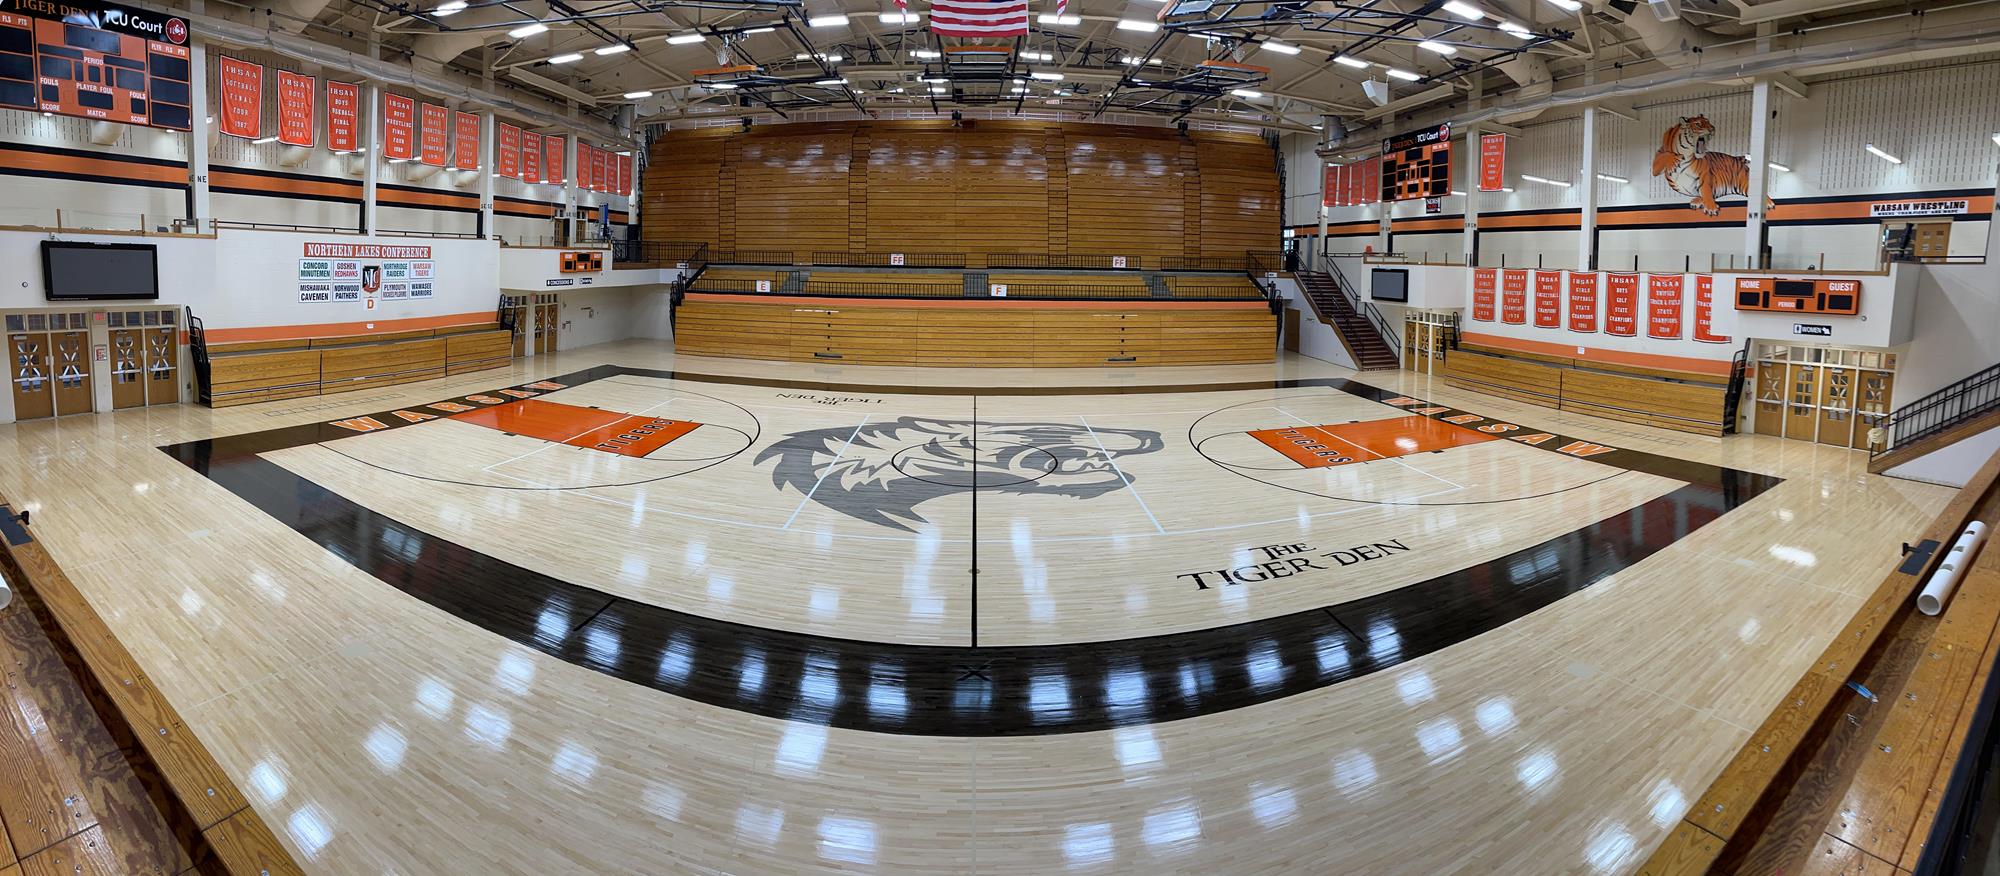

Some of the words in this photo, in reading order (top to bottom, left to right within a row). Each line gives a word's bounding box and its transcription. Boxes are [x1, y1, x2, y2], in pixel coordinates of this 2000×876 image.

[15, 0, 56, 15] TIGER
[104, 10, 128, 26] TCU
[131, 16, 163, 34] Court
[84, 57, 104, 65] PERIOD
[226, 65, 257, 79] IHSAA
[40, 77, 59, 87] FOULS
[282, 78, 310, 90] IHSAA
[76, 82, 98, 93] PLAYER
[100, 86, 114, 95] FOUL
[330, 88, 354, 97] IHSAA
[129, 91, 146, 100] FOULS
[230, 93, 252, 104] FINAL
[42, 103, 60, 111] SCORE
[335, 98, 349, 106] BOYS
[87, 109, 106, 118] MATCH
[131, 115, 147, 124] SCORE
[1874, 203, 1910, 212] WARSAW
[1913, 201, 1965, 211] WRESTLING
[355, 245, 380, 257] LAKES
[382, 246, 428, 258] CONFERENCE
[303, 262, 328, 270] CONCORD
[1740, 280, 1760, 289] HOME
[1829, 282, 1855, 292] GUEST
[368, 299, 374, 309] D
[1609, 315, 1633, 323] CHAMPIONS
[329, 381, 568, 432] WARSAW
[1381, 397, 1618, 458] WARSAW
[595, 418, 675, 451] TIGERS
[1274, 428, 1355, 464] TIGERS
[1247, 543, 1317, 560] THE
[1176, 557, 1330, 591] TIGER
[1320, 538, 1411, 567] DEN
